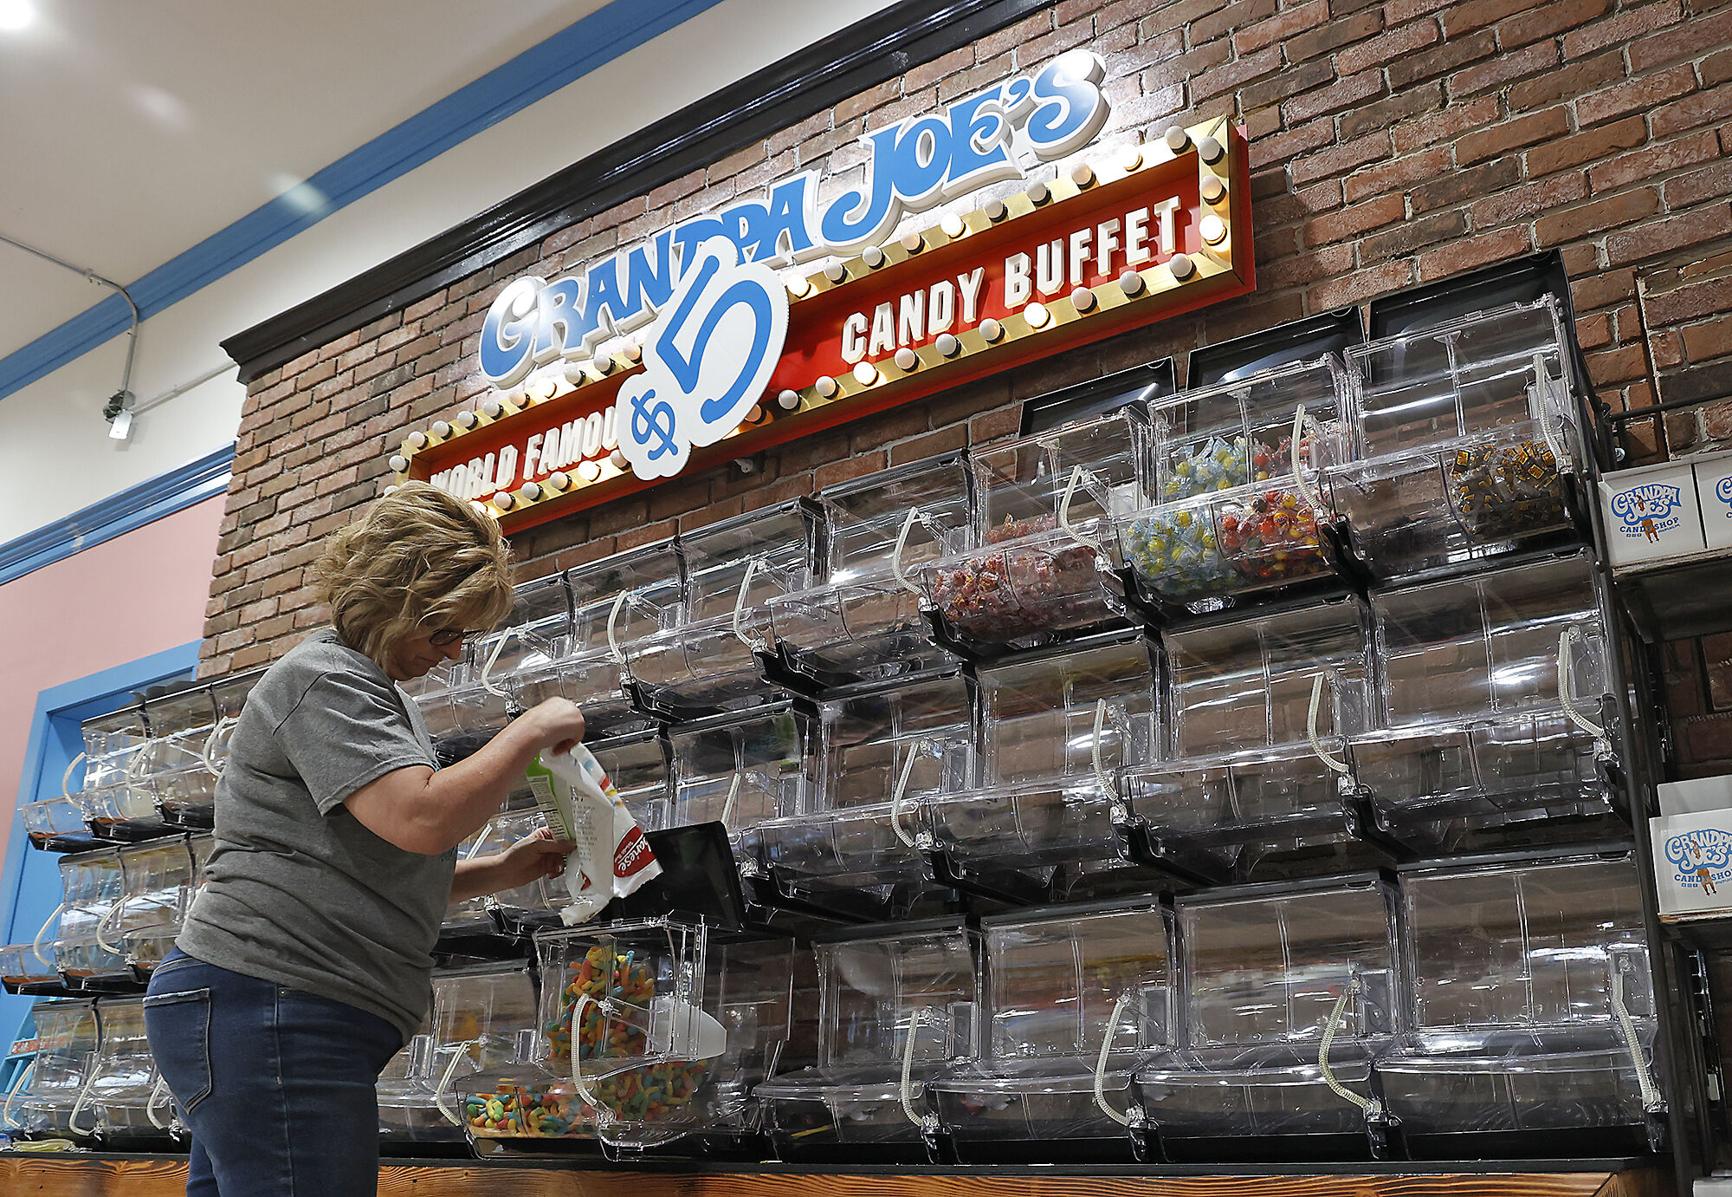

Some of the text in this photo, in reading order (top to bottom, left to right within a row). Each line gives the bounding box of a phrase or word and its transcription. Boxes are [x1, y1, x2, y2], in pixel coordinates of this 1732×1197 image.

[818, 49, 1108, 254] JOE'S
[524, 406, 618, 480] FAMOU
[841, 266, 985, 364] CANDY
[1003, 196, 1181, 309] BUFFET
[1611, 485, 1681, 517] GRANDPA
[1654, 517, 1679, 530] SHOP
[1674, 870, 1732, 883] CAND SHO
